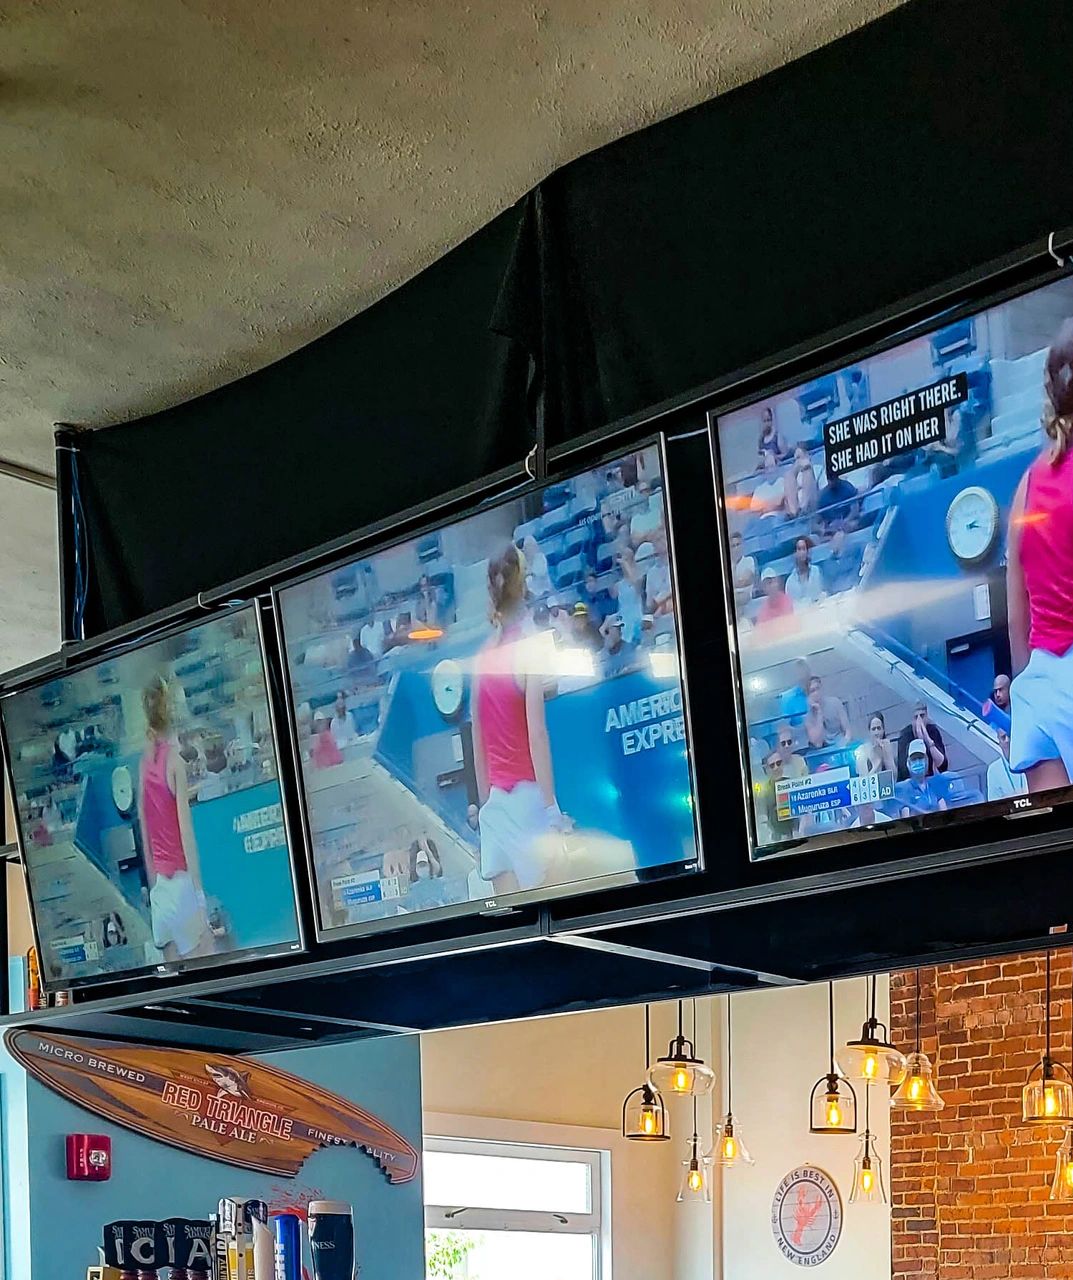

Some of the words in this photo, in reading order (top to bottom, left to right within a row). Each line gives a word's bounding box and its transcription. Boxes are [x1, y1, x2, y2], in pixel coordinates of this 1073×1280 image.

[829, 420, 851, 445] SHE
[853, 411, 878, 436] WAS
[881, 396, 915, 429] RIGHT
[918, 379, 962, 411] THERE.
[831, 448, 853, 472] SHE
[856, 440, 879, 464] HAD
[882, 434, 893, 455] IT
[896, 427, 913, 449] ON
[915, 420, 940, 444] HER
[880, 786, 892, 797] AD
[1013, 798, 1032, 809] TCL
[39, 1042, 84, 1063] MICRO
[88, 1058, 145, 1082] BREWED
[162, 1081, 202, 1111] RED
[206, 1094, 293, 1141] TRIANGLE
[192, 1114, 227, 1136] PALE
[229, 1127, 257, 1144] ALE
[776, 1179, 790, 1202] LIFE
[791, 1171, 800, 1181] IS
[803, 1170, 825, 1184] BEST
[825, 1184, 835, 1198] IN
[777, 1237, 796, 1260] NEW
[798, 1234, 836, 1265] ENGLAND
